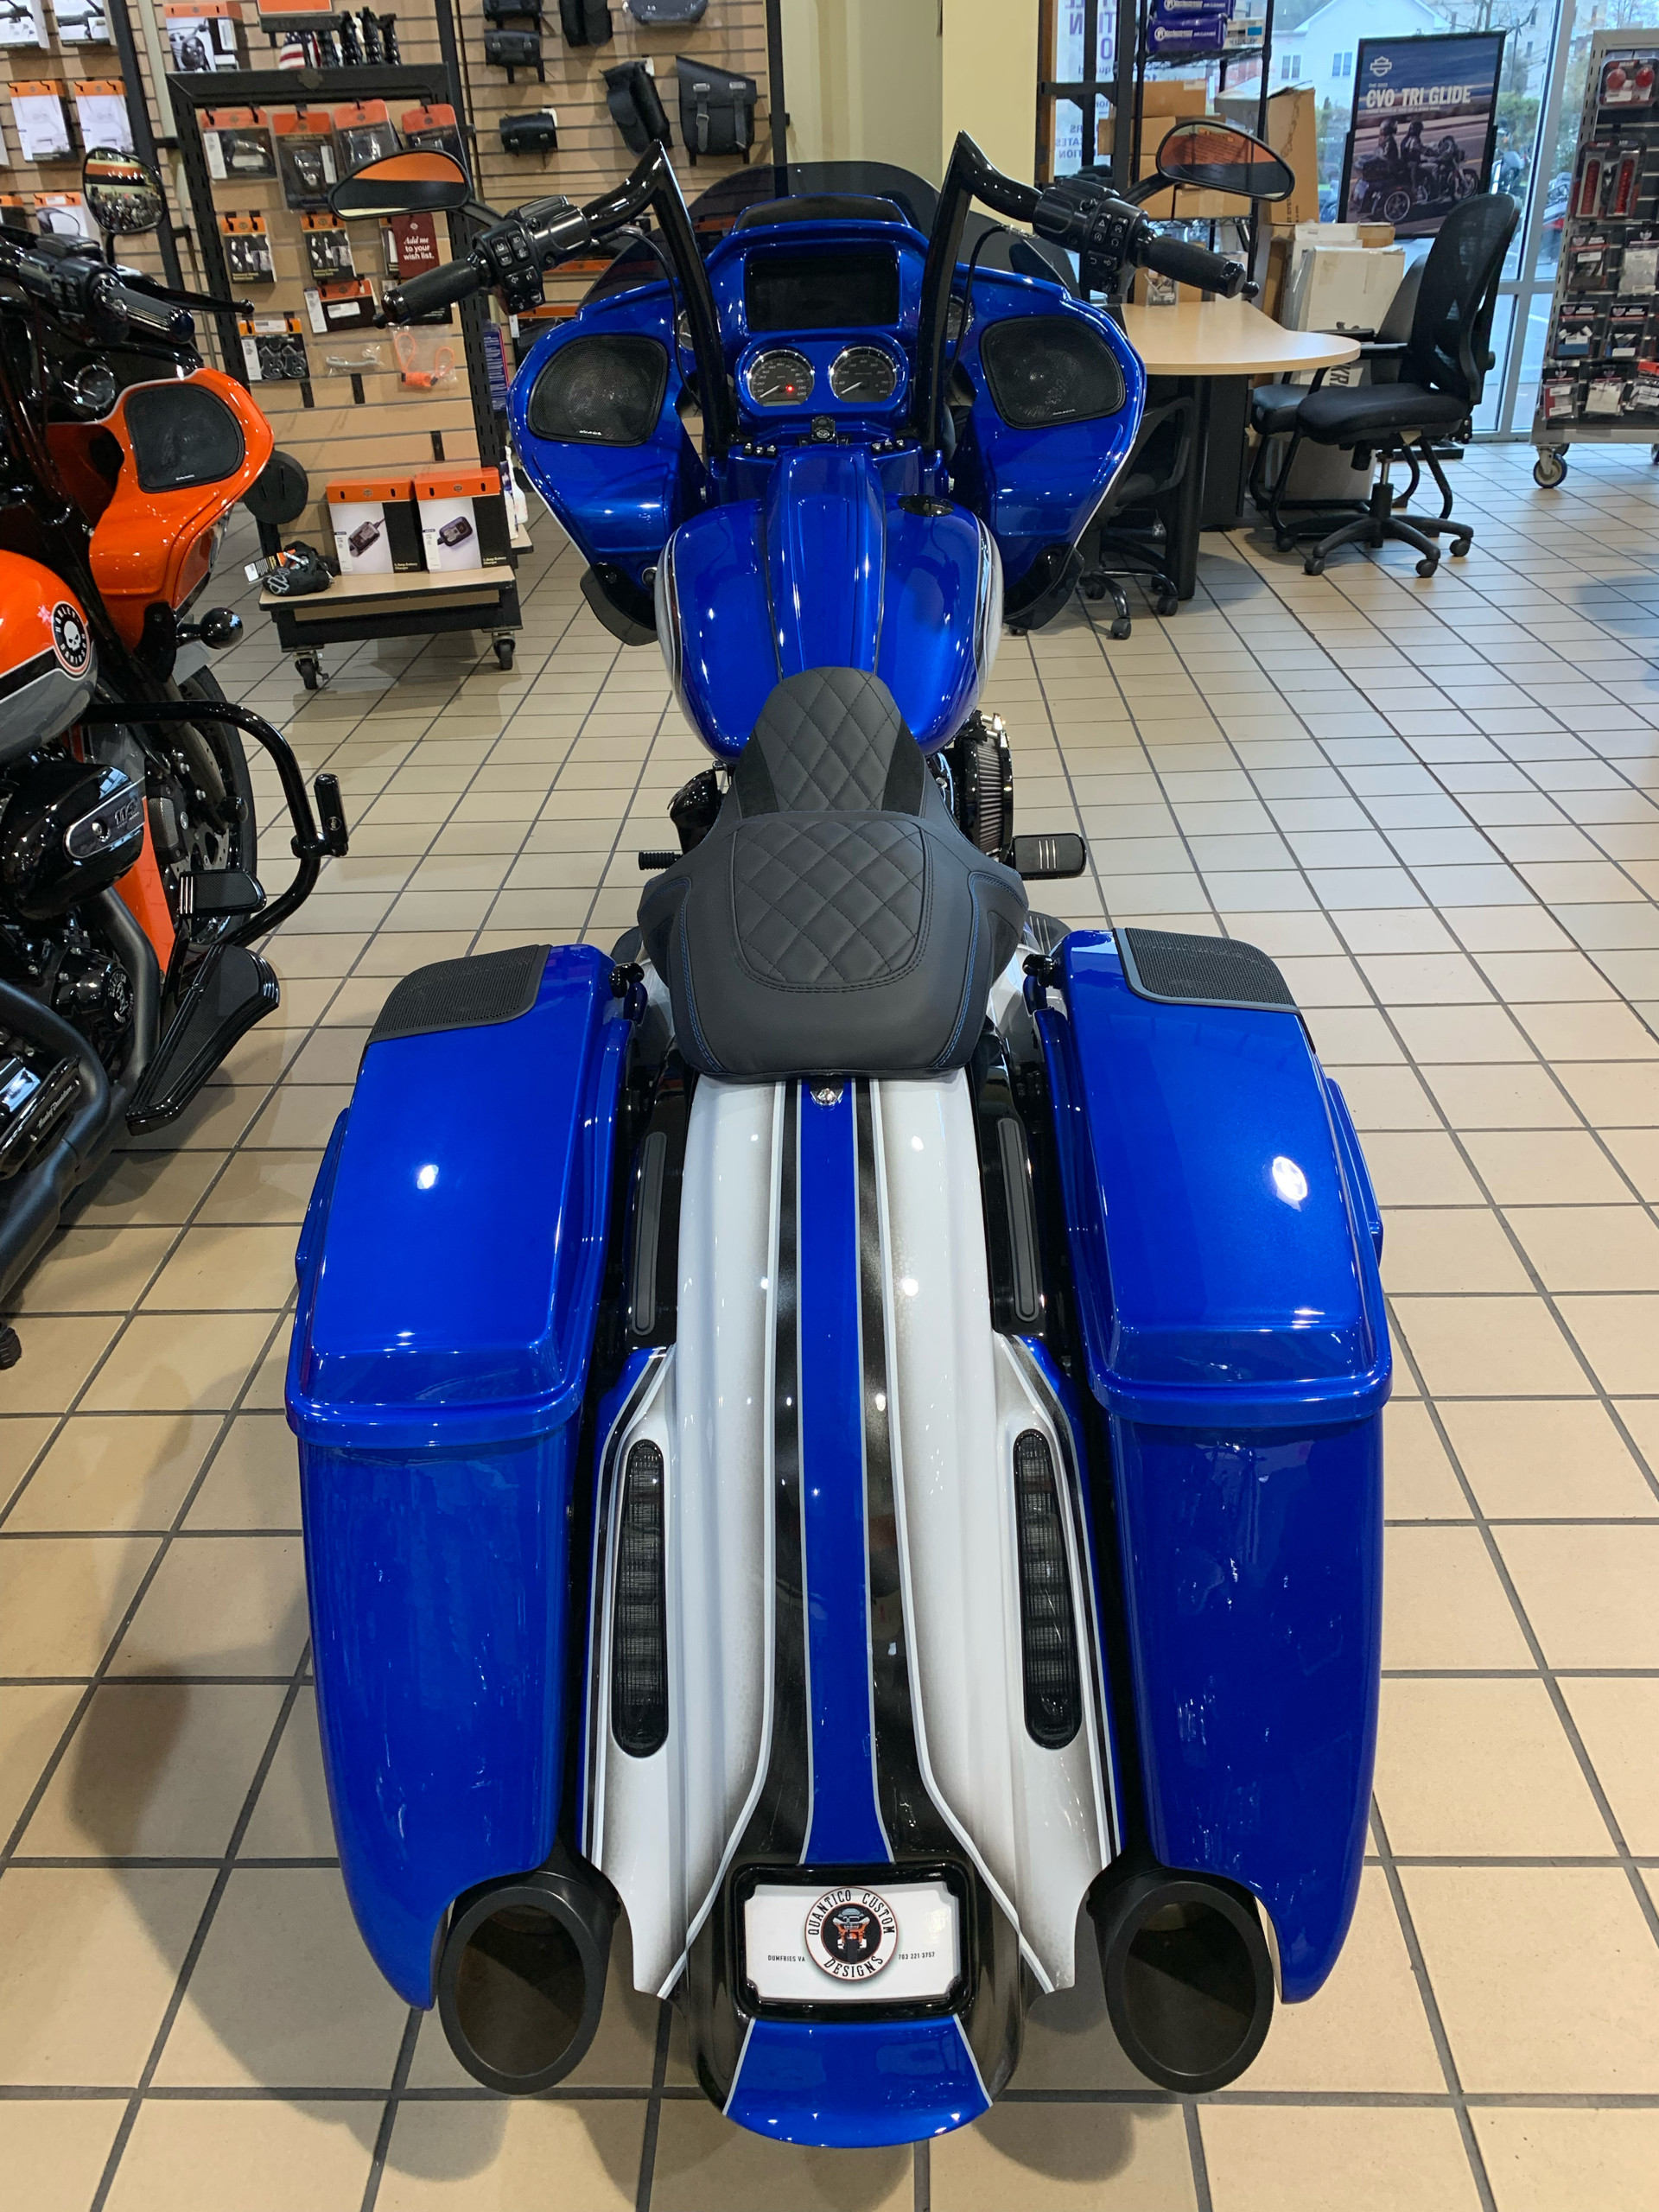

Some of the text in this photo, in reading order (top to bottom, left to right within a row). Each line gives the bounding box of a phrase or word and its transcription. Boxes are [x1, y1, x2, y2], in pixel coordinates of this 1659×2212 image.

[1402, 87, 1424, 106] TRI
[1429, 85, 1471, 105] GLIDE
[404, 235, 419, 245] Add
[808, 1889, 896, 1936] QUANTICO CUSTOM
[823, 1955, 884, 1978] DESIGNS
